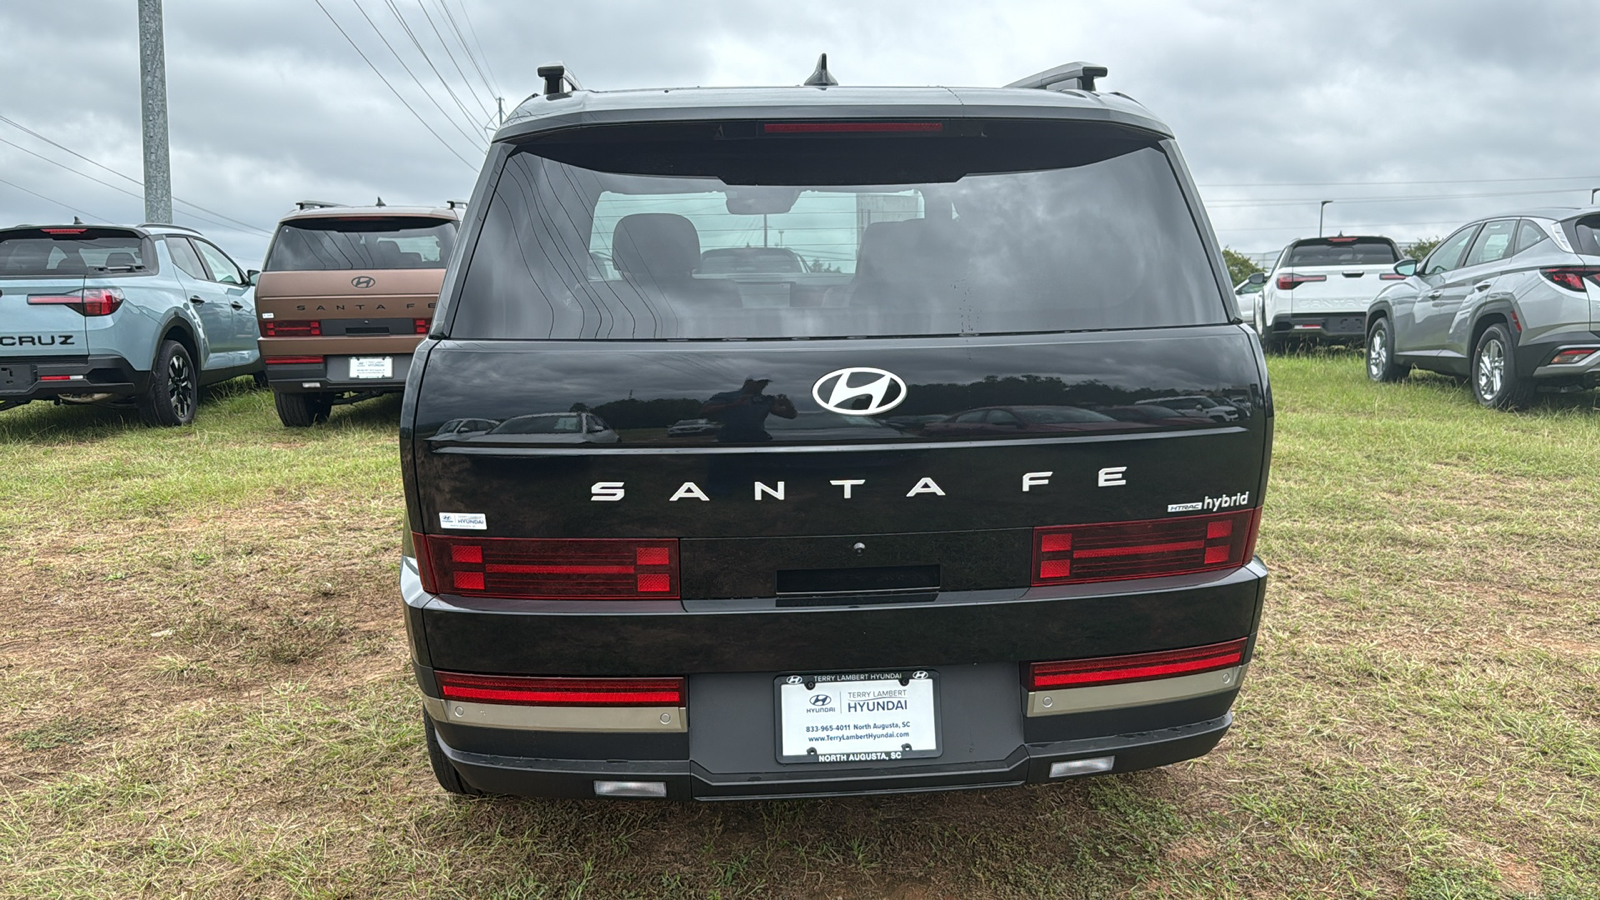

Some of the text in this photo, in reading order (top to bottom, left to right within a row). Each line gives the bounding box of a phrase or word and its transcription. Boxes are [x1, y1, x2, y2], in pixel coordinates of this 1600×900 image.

[0, 335, 75, 346] CRUZ
[590, 466, 1127, 502] SANTA FE
[1169, 491, 1250, 512] HTRAC hybrid
[837, 674, 869, 682] LAMBERT
[870, 673, 902, 681] HYUNDAI
[847, 689, 907, 699] TERRY LAMBERT
[848, 699, 908, 713] HYUNDAI
[805, 721, 911, 733] 833-965-4011 North Augusta, SC
[808, 731, 910, 742] www.TerryLambertHyundai.com
[818, 751, 902, 763] NORTH AUGUSTA, SC
